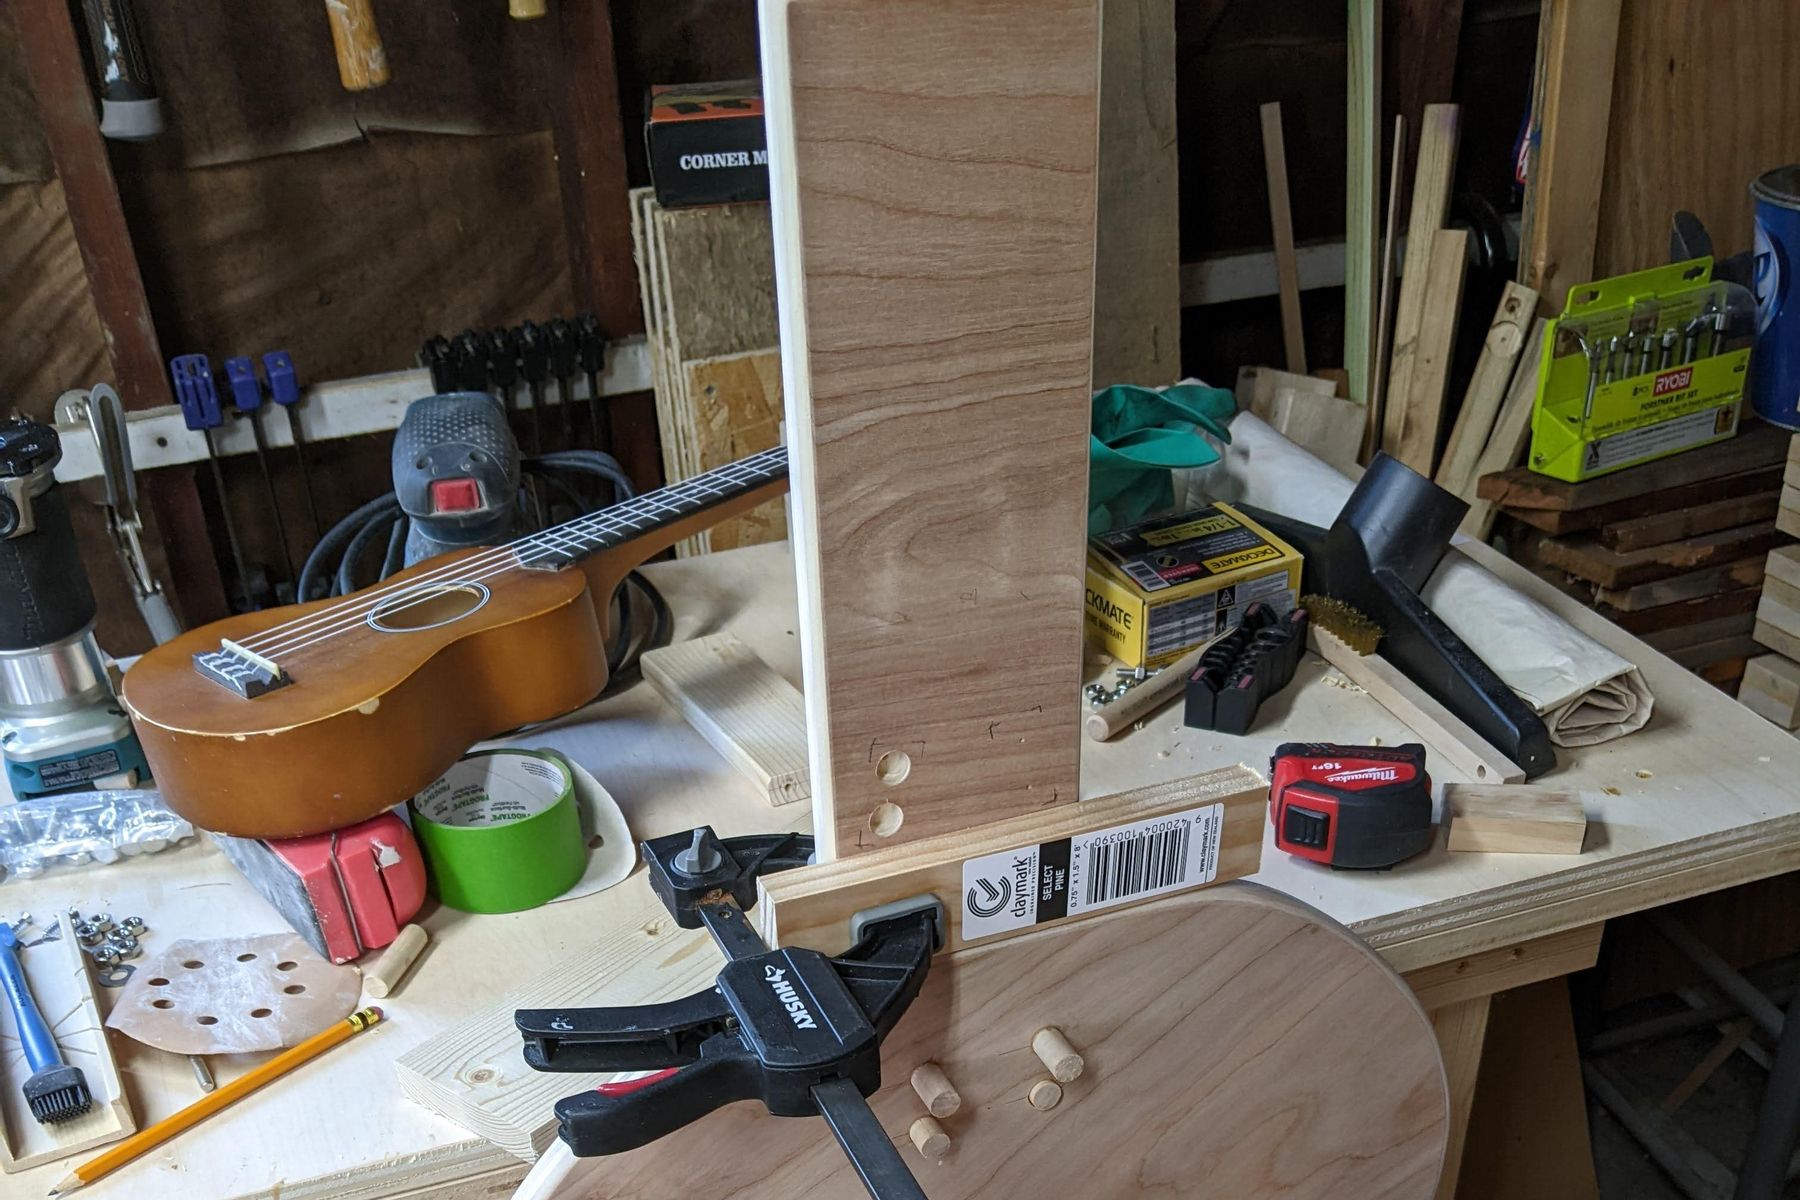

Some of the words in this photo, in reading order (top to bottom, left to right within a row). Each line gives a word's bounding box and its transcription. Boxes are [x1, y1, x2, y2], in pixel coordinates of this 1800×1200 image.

[680, 152, 750, 170] CORNER
[1655, 371, 1691, 392] RYOBI
[1211, 548, 1275, 569] DECKMATE
[1085, 589, 1132, 630] CKMATE
[1327, 770, 1399, 783] Milwaukee
[1145, 818, 1188, 836] 420004
[1195, 814, 1202, 824] 9
[1094, 829, 1137, 847] 100390
[1199, 817, 1210, 873] www.claymark.com
[1043, 865, 1053, 901] SELECT
[1054, 868, 1065, 891] PINE
[771, 980, 818, 1030] HUSKY
